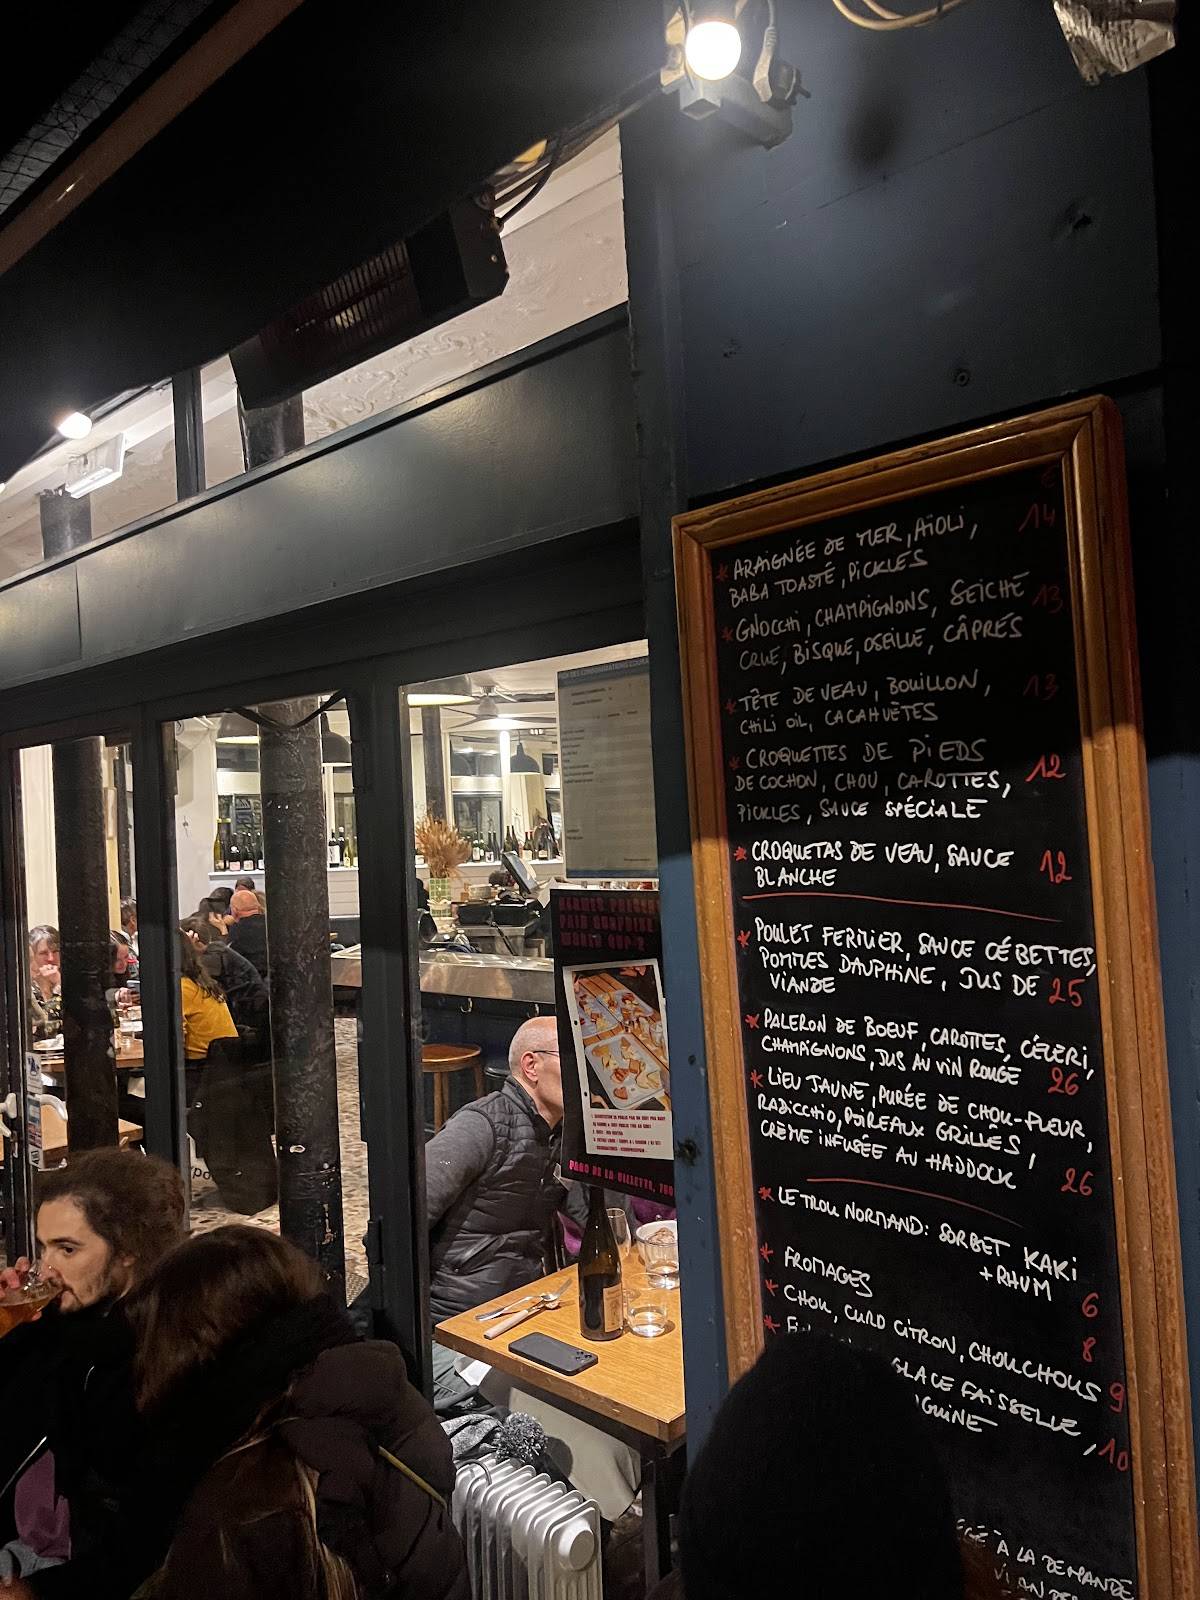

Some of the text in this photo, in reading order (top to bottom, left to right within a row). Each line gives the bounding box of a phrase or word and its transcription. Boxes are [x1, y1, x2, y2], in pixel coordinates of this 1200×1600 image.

[1019, 504, 1055, 533] 14
[824, 535, 845, 556] DE
[729, 583, 769, 607] BABA
[848, 549, 928, 582] PICKLES
[815, 589, 937, 626] CHAMPIGNONS,
[1031, 584, 1063, 614] 13
[793, 637, 860, 665] BISQUE,
[738, 687, 780, 712] TÊTE
[793, 686, 816, 704] DE
[1023, 674, 1059, 700] 13
[740, 718, 776, 736] CHILI
[745, 734, 987, 769] CROQUETTES DE PIEDS
[1025, 754, 1067, 783] 12
[735, 770, 1012, 798] DE COCHON, CHOU, CAROTTES,
[821, 798, 867, 818] SAUCE
[750, 840, 1014, 873] CROQUETAS DE VEAU, SAUCE
[1039, 849, 1072, 883] 12
[754, 866, 837, 888] BLANCHE
[754, 917, 813, 945] POULET
[918, 932, 975, 958] SAUCE
[758, 946, 829, 970] POMMES
[959, 967, 1007, 992] JUS
[1012, 974, 1040, 998] DE
[769, 970, 836, 994] VIANDE
[1049, 978, 1085, 1007] 25
[764, 1008, 827, 1034] PALERON
[835, 1018, 855, 1035] DE
[874, 1048, 906, 1072] JUS
[912, 1052, 931, 1073] AU
[937, 1056, 963, 1075] VIN
[969, 1062, 1022, 1086] ROUGE
[1047, 1066, 1080, 1096] 26
[767, 1066, 801, 1091] LIEU
[878, 1083, 928, 1110] PURÉE
[938, 1094, 960, 1112] DE
[844, 1106, 925, 1137] POIREAUX
[895, 1146, 918, 1167] AU
[926, 1152, 1016, 1190] HADDOCK
[1060, 1167, 1094, 1196] 26
[778, 1185, 800, 1206] LE
[800, 1192, 840, 1218] TROU
[939, 1222, 1010, 1258] SORBET
[1023, 1246, 1078, 1282] KAKI
[784, 1246, 873, 1298] FROMAGES
[1081, 1292, 1100, 1318] 6
[844, 1303, 886, 1330] CURD
[969, 1342, 1102, 1403] CHOUCHOUS
[1081, 1337, 1096, 1362] 8
[891, 1357, 955, 1392] GLACE
[1109, 1382, 1125, 1413] 9
[915, 1395, 999, 1433] GUINE
[1098, 1438, 1129, 1471] 10
[1017, 1545, 1036, 1566] LA
